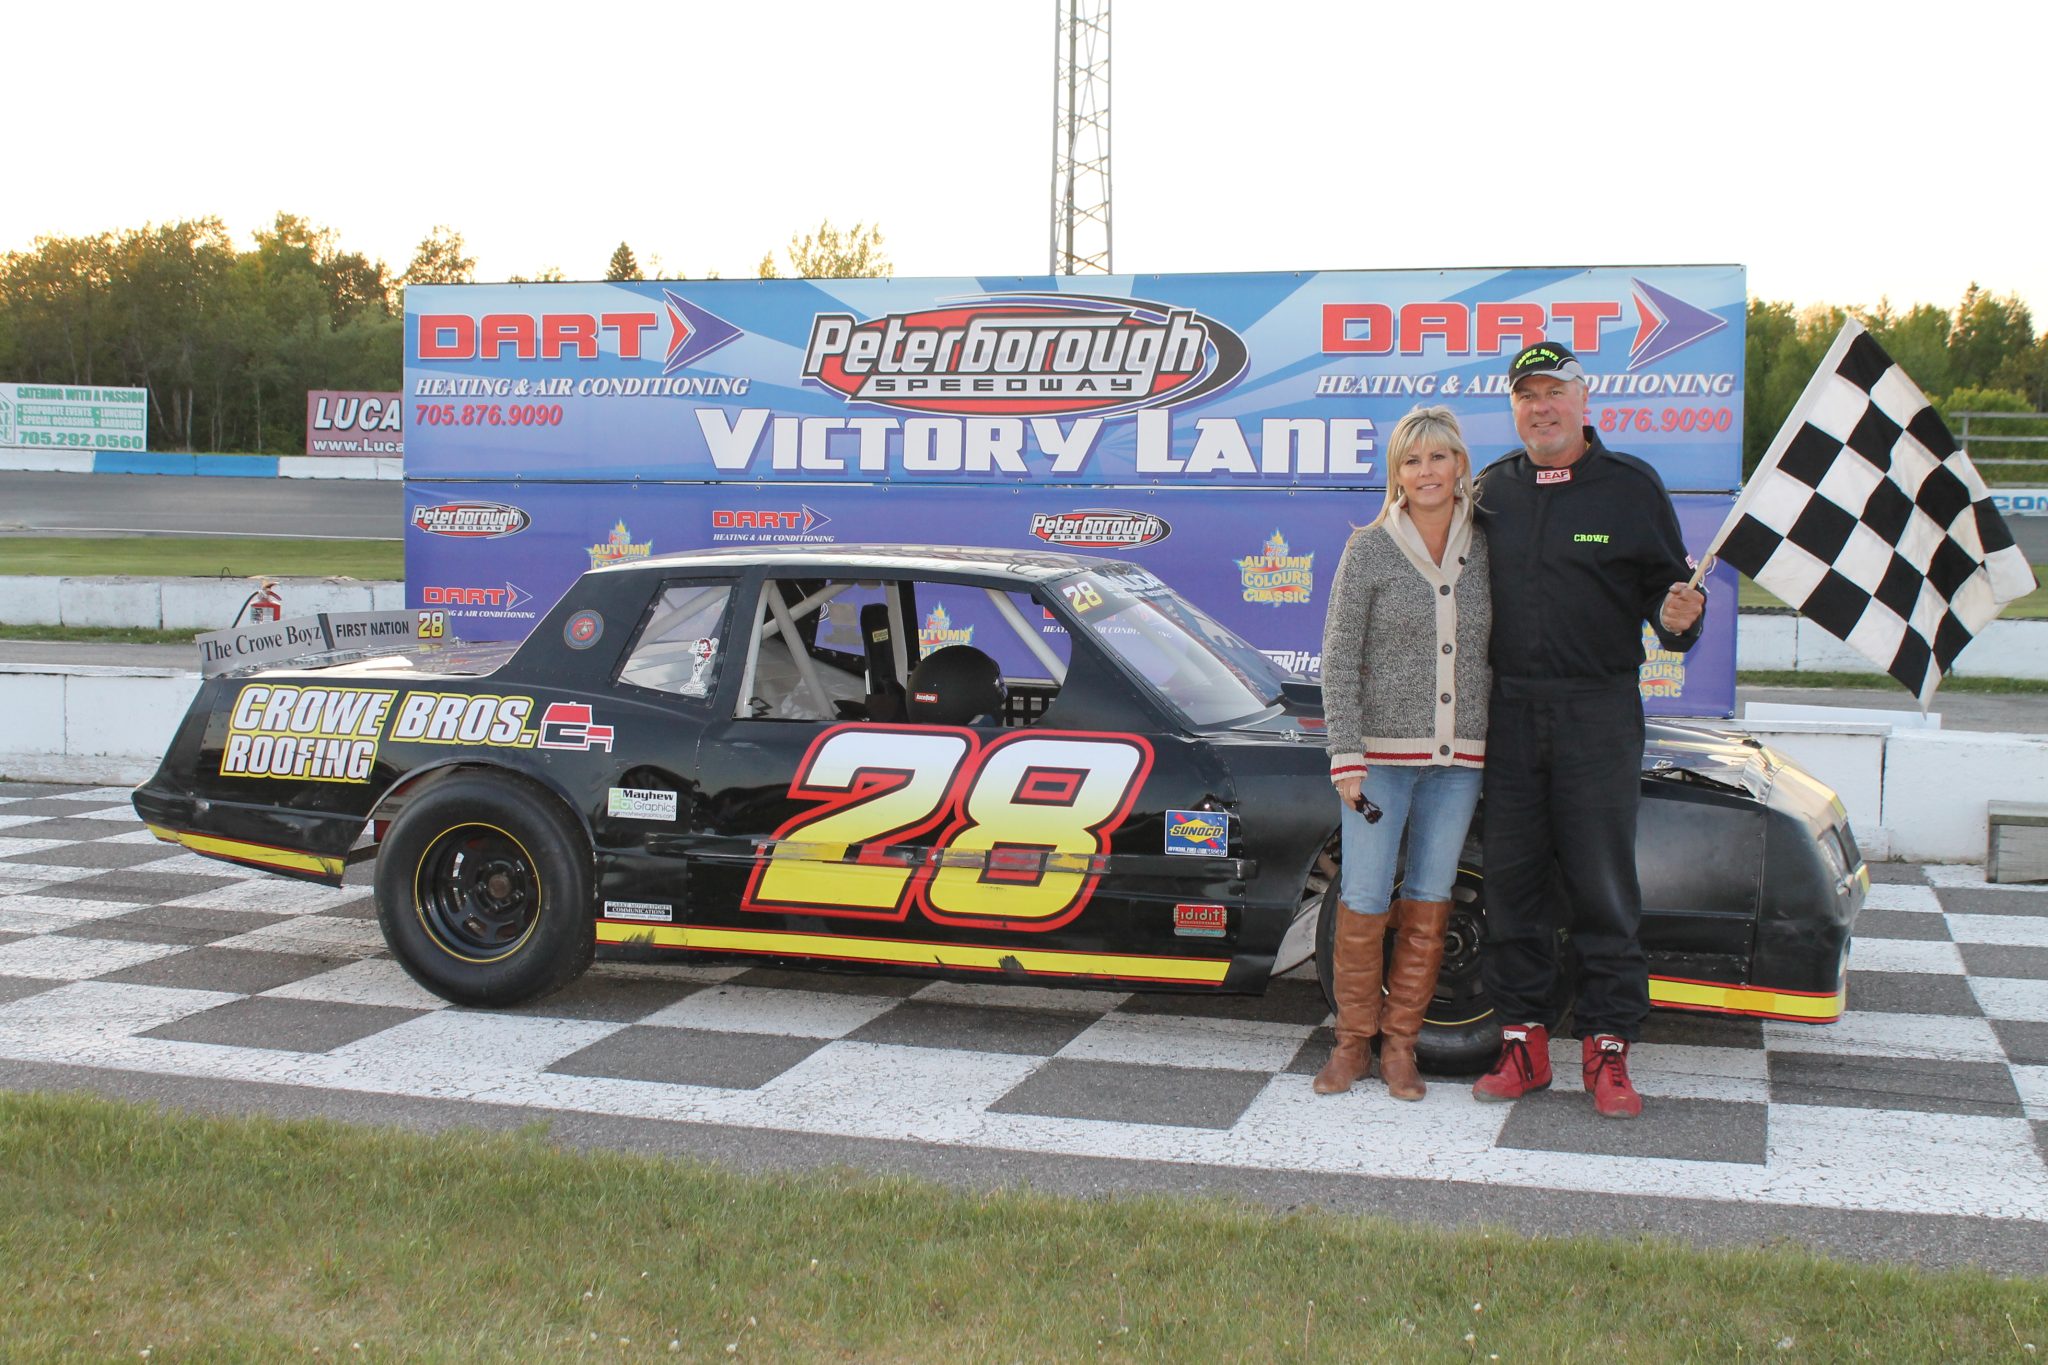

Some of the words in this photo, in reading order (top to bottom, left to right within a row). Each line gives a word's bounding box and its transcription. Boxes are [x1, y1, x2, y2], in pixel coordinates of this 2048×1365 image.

[418, 312, 657, 359] DART
[1321, 302, 1621, 353] DART
[803, 310, 1205, 376] Peterborough
[1540, 348, 1559, 361] BOYZ
[415, 378, 510, 397] HEATING
[513, 378, 530, 397] &
[533, 378, 574, 396] AIR
[587, 378, 749, 396] CONDITIONING
[875, 378, 1133, 392] SPEEDWAY
[1315, 375, 1438, 395] HEATING
[1440, 375, 1460, 394] &
[1463, 375, 1512, 395] AIR
[1585, 374, 1734, 394] DITIONING
[17, 387, 63, 400] CATERING
[65, 388, 92, 401] WITH
[94, 390, 101, 401] A
[103, 390, 145, 403] PASSION
[65, 407, 92, 417] EVENTS
[415, 404, 562, 426] 705.876.9090
[20, 432, 143, 449] 705.292.0560
[695, 408, 1103, 473] VICTORY
[1135, 408, 1374, 473] LANE
[1538, 471, 1568, 479] LEAF
[412, 506, 520, 527] Peterborough
[713, 510, 801, 529] DART
[1030, 514, 1159, 537] Peterborough
[713, 533, 750, 542] HEATING
[750, 533, 756, 541] &
[758, 534, 772, 542] AIR
[773, 534, 834, 543] CONDITIONING
[1573, 534, 1610, 543] CROWE
[592, 543, 650, 556] AUTUMN
[1243, 555, 1311, 571] AUTUMN
[1244, 569, 1312, 588] COLOURS
[424, 586, 505, 606] DART
[1062, 581, 1103, 613] 28
[1243, 588, 1311, 603] CLASSIC
[479, 610, 536, 619] CONDITIONING
[336, 622, 367, 638] FIRST
[370, 621, 409, 636] NATION
[418, 611, 445, 639] 28
[202, 639, 232, 661] The
[235, 626, 283, 655] Crowe
[285, 618, 322, 646] Boyz
[918, 628, 971, 642] UTUMN
[233, 687, 397, 736] CROWE
[394, 694, 535, 744] BROS.
[224, 735, 376, 780] ROOFING
[623, 789, 674, 801] Mayhew
[633, 801, 676, 812] Graphics
[744, 723, 1152, 931] 28
[1172, 825, 1223, 837] SUNOCO
[612, 907, 666, 915] COMMUNICATIONS
[1181, 908, 1220, 922] ididit
